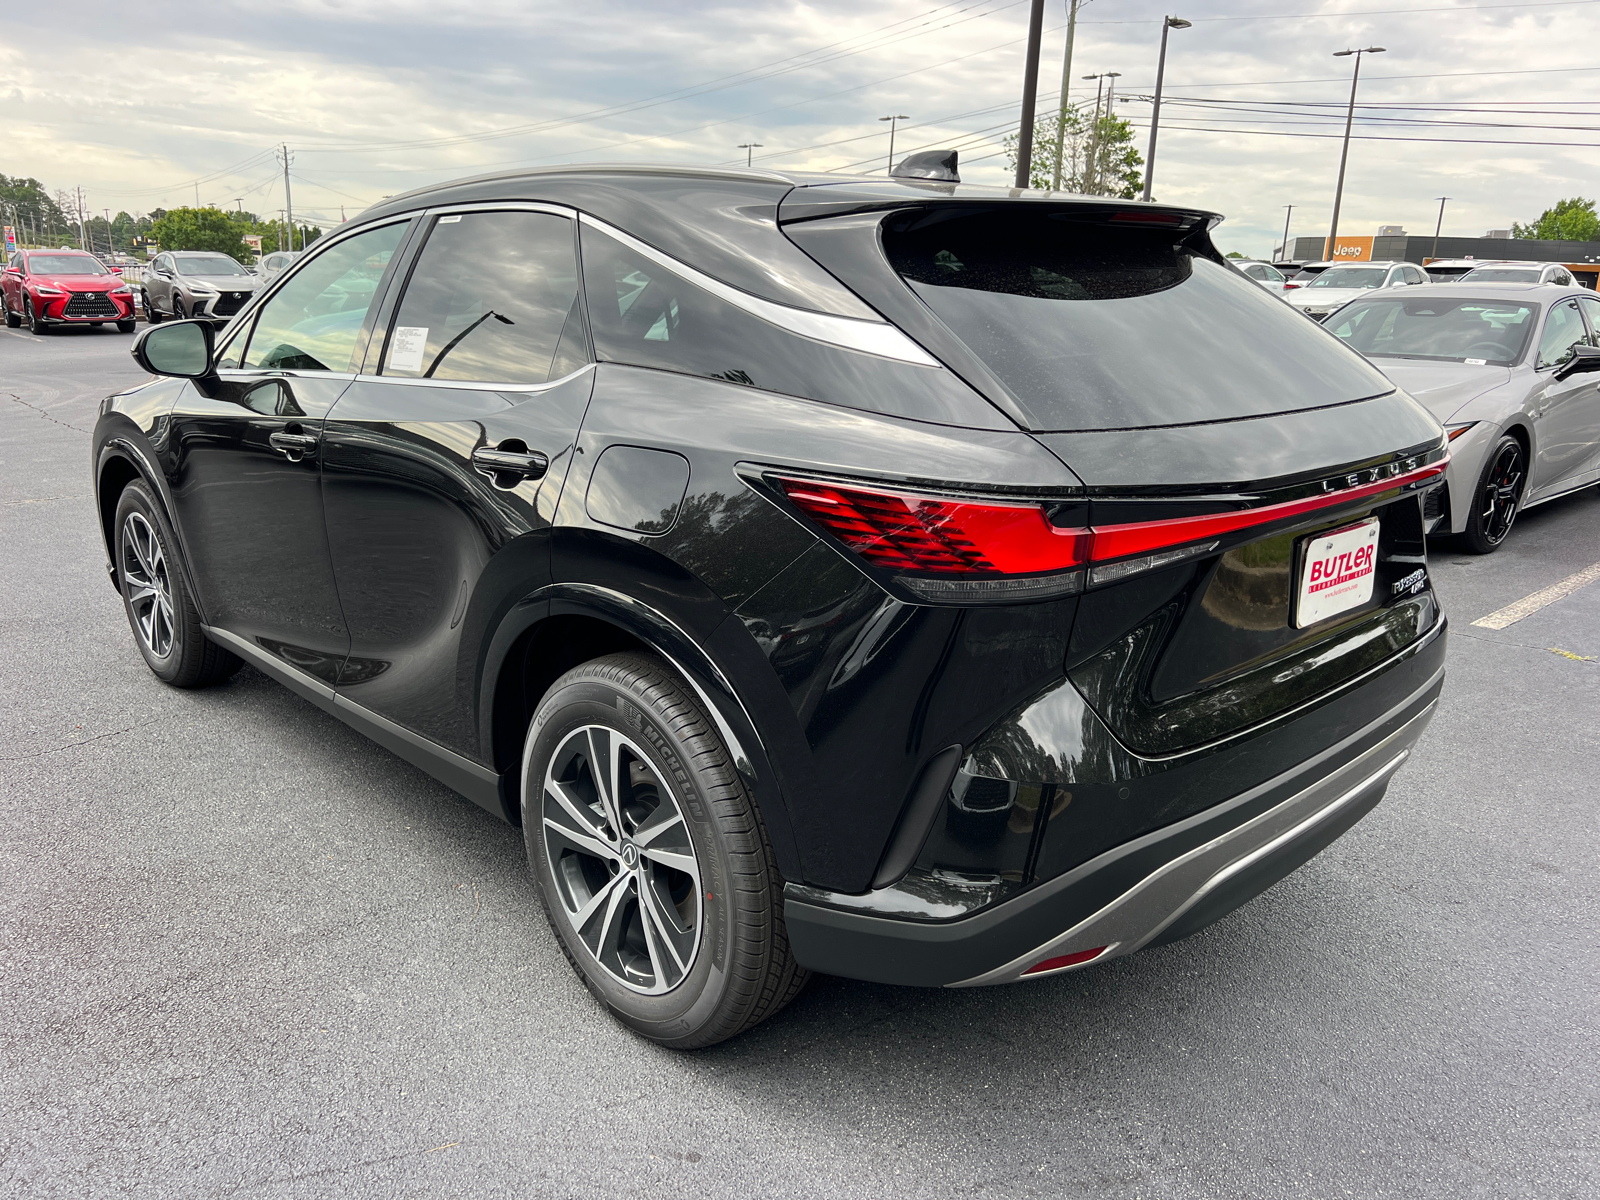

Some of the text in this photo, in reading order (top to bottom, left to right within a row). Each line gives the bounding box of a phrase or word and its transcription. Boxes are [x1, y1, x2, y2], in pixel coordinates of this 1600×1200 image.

[1333, 244, 1362, 258] Jeep
[1321, 458, 1416, 492] LEXUS
[643, 725, 704, 817] MICHELIN
[704, 836, 723, 900] PRIMACY
[716, 927, 725, 962] SEASON
